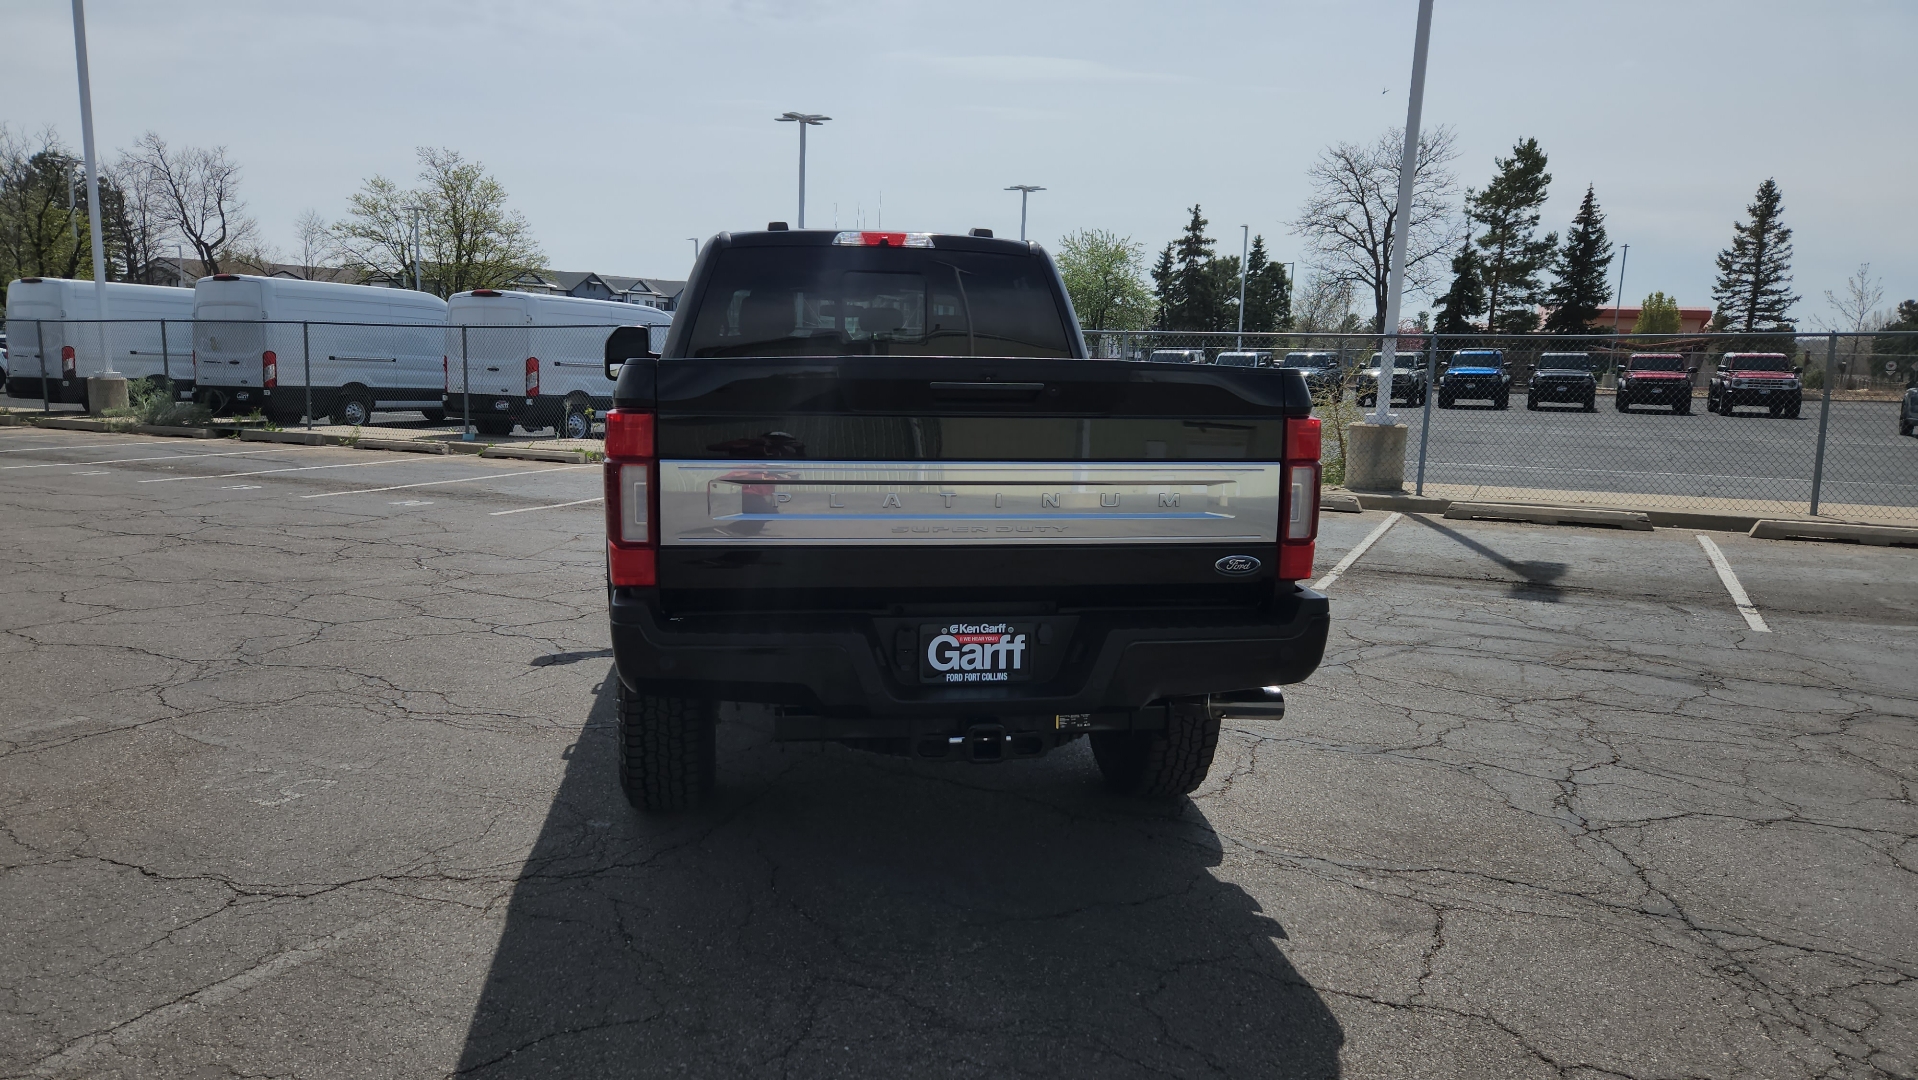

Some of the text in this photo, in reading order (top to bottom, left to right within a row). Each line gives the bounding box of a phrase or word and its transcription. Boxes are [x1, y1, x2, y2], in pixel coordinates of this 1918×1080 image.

[772, 492, 1181, 508] PLATINUM
[1226, 559, 1252, 570] Ford
[960, 623, 1006, 634] Ken Garff
[927, 634, 1026, 671] Garff
[946, 672, 1008, 682] FORD FORT COLLINS
